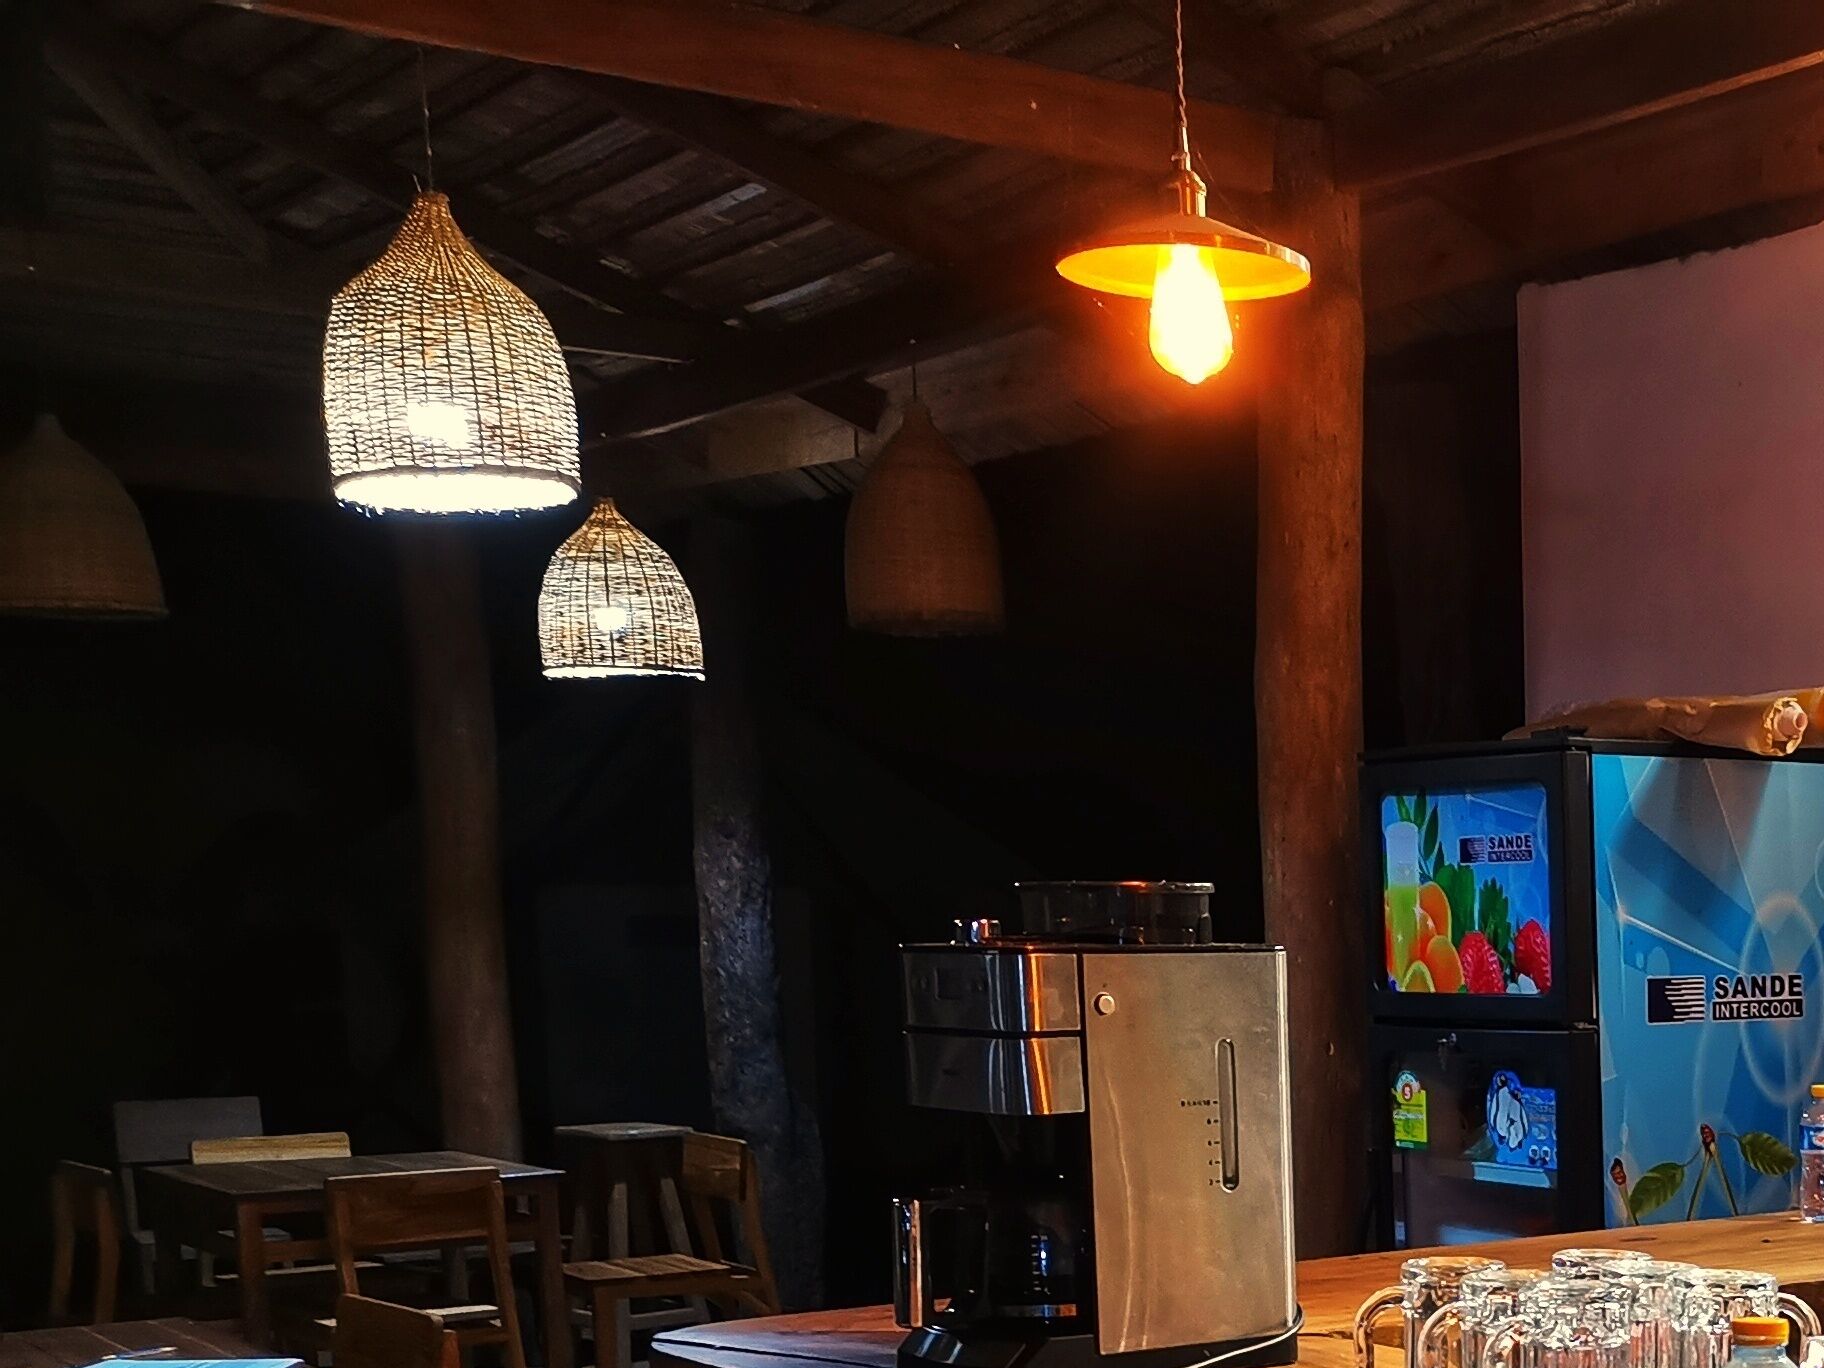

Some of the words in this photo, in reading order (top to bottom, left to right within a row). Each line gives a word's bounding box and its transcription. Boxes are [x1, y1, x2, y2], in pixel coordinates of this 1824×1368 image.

[1488, 834, 1532, 850] SANDE
[1714, 974, 1803, 1000] SANDE
[1715, 1001, 1801, 1018] INTERCOOL
